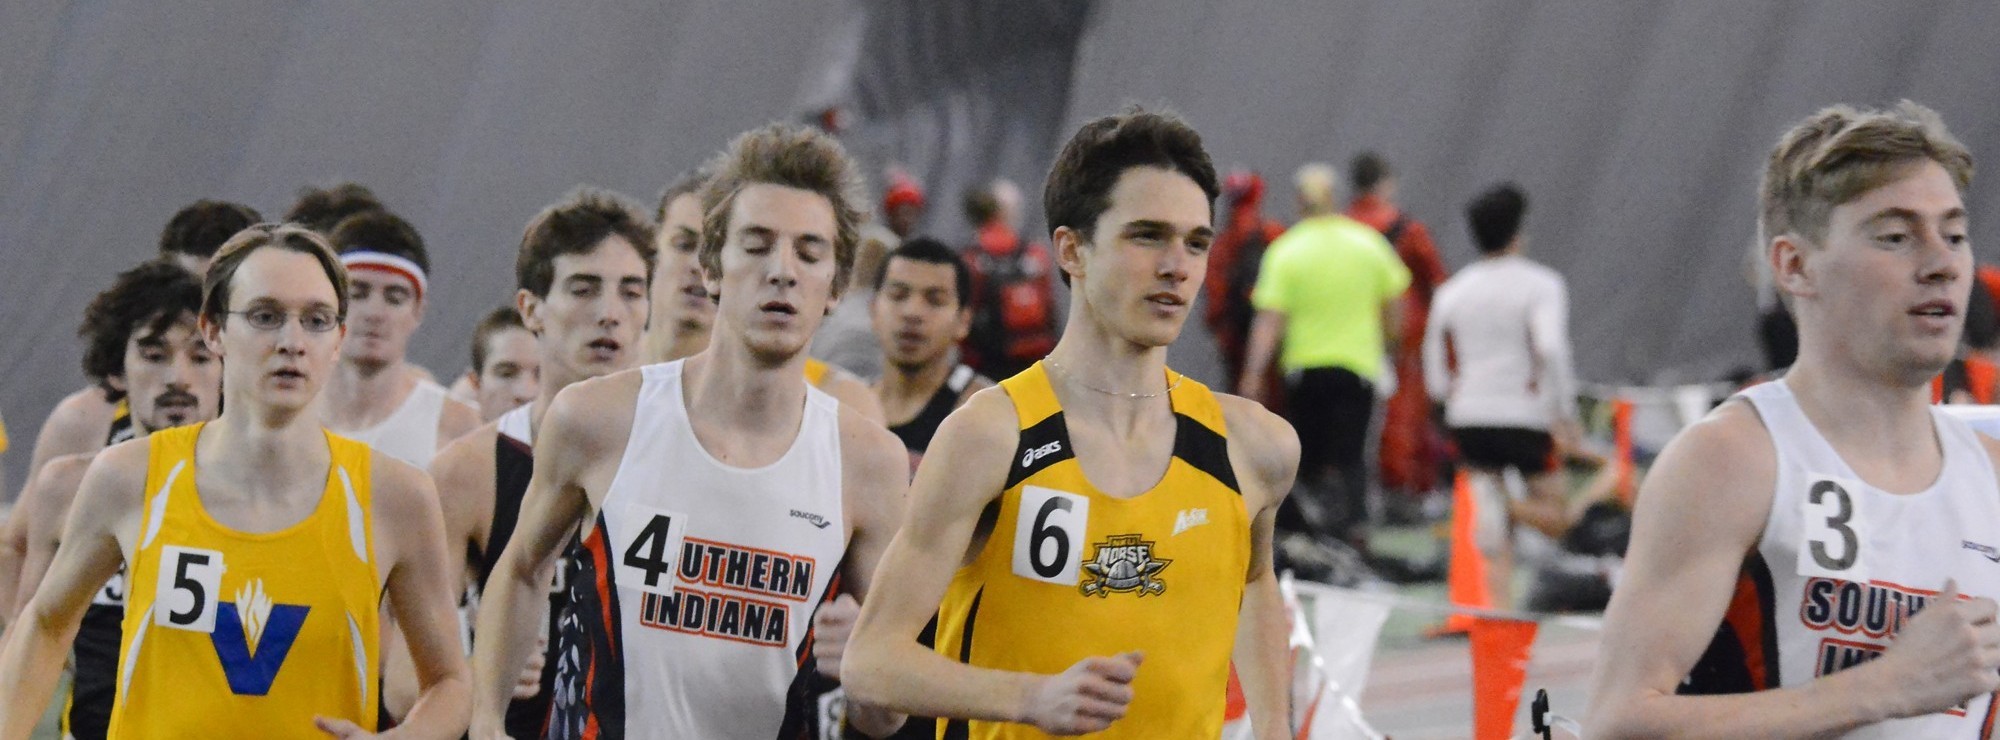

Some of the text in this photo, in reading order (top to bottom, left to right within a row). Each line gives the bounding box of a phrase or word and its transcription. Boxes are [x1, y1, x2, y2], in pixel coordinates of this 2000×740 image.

[624, 514, 671, 587] 4
[790, 509, 824, 524] saucony
[1030, 496, 1073, 578] 6
[1808, 480, 1859, 571] 3
[169, 552, 210, 625] 5
[640, 587, 789, 648] INDIANA
[210, 602, 311, 696] V
